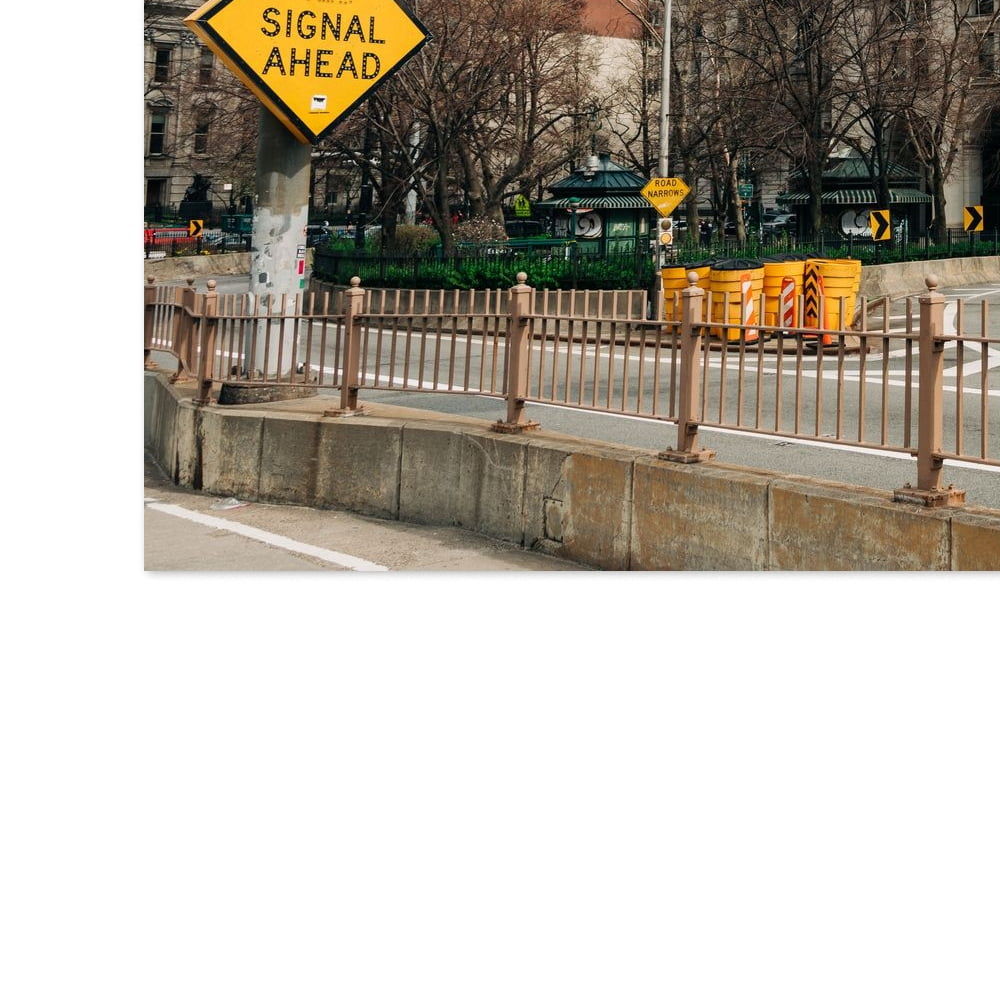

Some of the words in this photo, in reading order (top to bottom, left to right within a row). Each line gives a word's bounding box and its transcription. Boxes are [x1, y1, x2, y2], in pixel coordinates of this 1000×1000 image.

[260, 7, 385, 44] SIGNAL
[262, 46, 381, 80] AHEAD
[647, 189, 684, 198] NARROWS
[654, 179, 677, 187] ROAD
